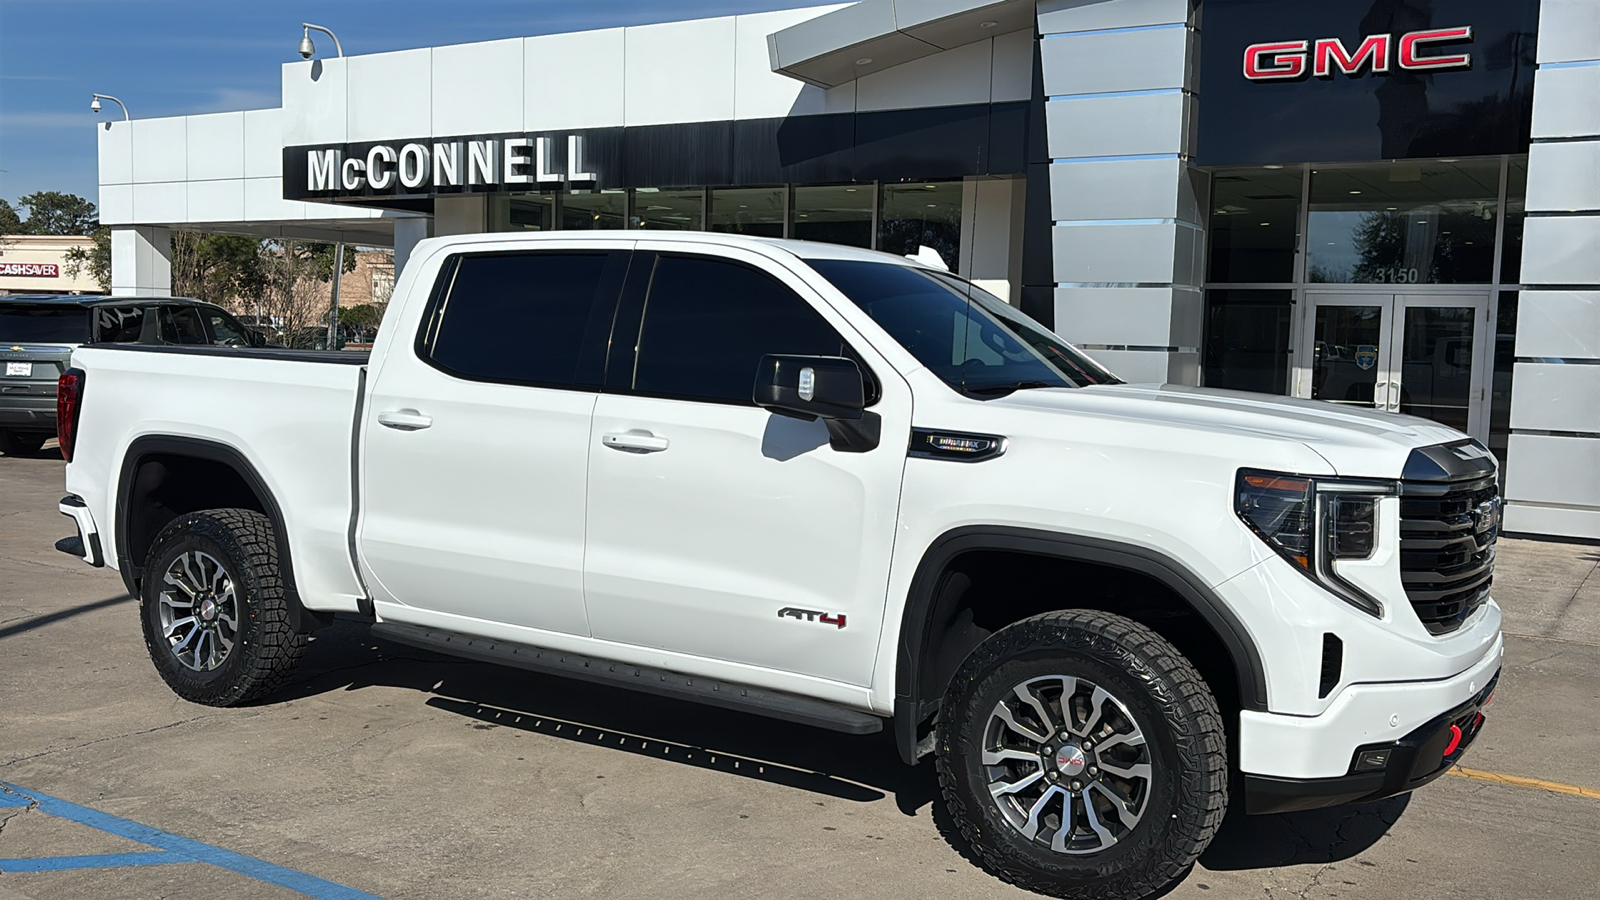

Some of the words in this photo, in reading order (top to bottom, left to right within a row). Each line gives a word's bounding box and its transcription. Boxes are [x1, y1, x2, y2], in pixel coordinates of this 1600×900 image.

[1243, 25, 1473, 80] GMC
[306, 135, 597, 191] McCONNELL
[1375, 267, 1419, 284] 3150
[777, 606, 847, 630] AT4
